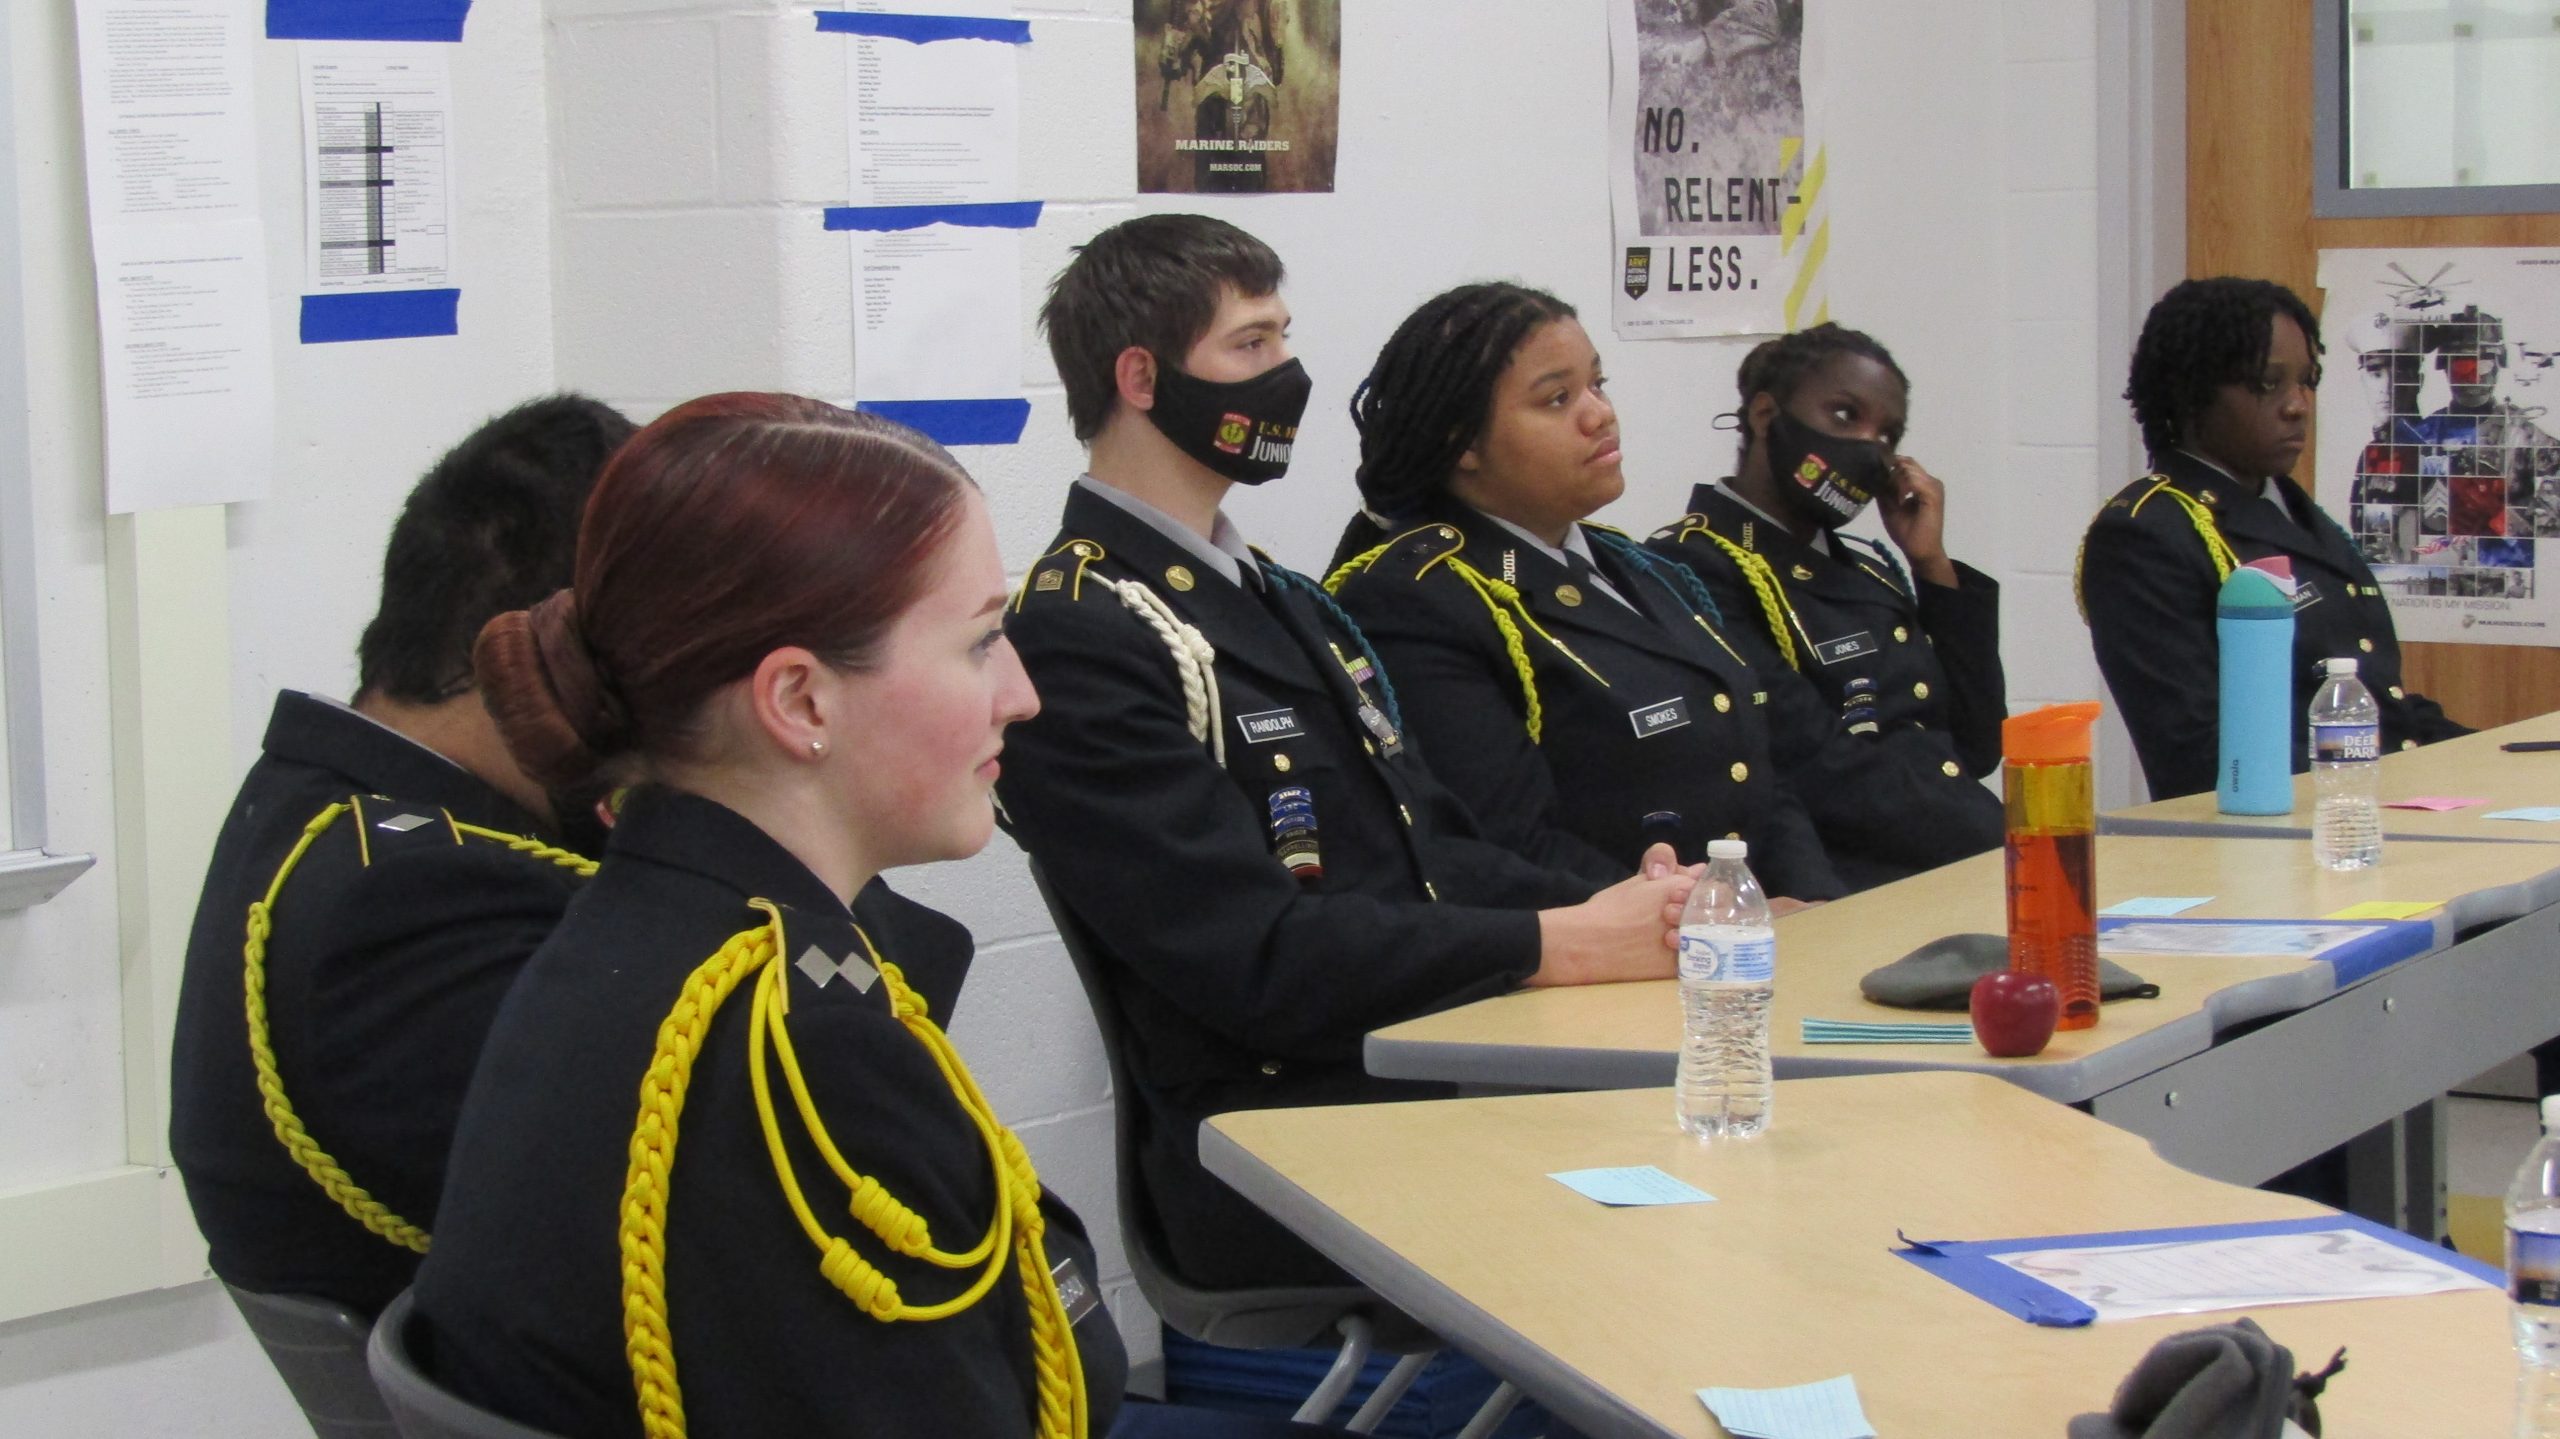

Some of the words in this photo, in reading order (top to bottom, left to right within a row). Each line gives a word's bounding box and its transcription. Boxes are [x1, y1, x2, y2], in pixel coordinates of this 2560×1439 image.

[1643, 107, 1699, 153] NO.
[1175, 139, 1234, 151] MARINE
[1238, 139, 1289, 152] RAIDERS
[1209, 163, 1262, 172] MARSOC.COM
[1664, 177, 1801, 223] RELENT-
[1628, 257, 1648, 267] ARMY
[1667, 246, 1758, 292] LESS.
[1626, 274, 1647, 284] GUARD
[2292, 590, 2310, 604] MAN
[2432, 599, 2442, 609] IS
[2445, 600, 2460, 609] MY
[1834, 640, 1860, 656] JONES
[1249, 715, 1295, 734] RANDOLPH
[1645, 707, 1678, 728] SMOKES
[2231, 759, 2240, 793] owala
